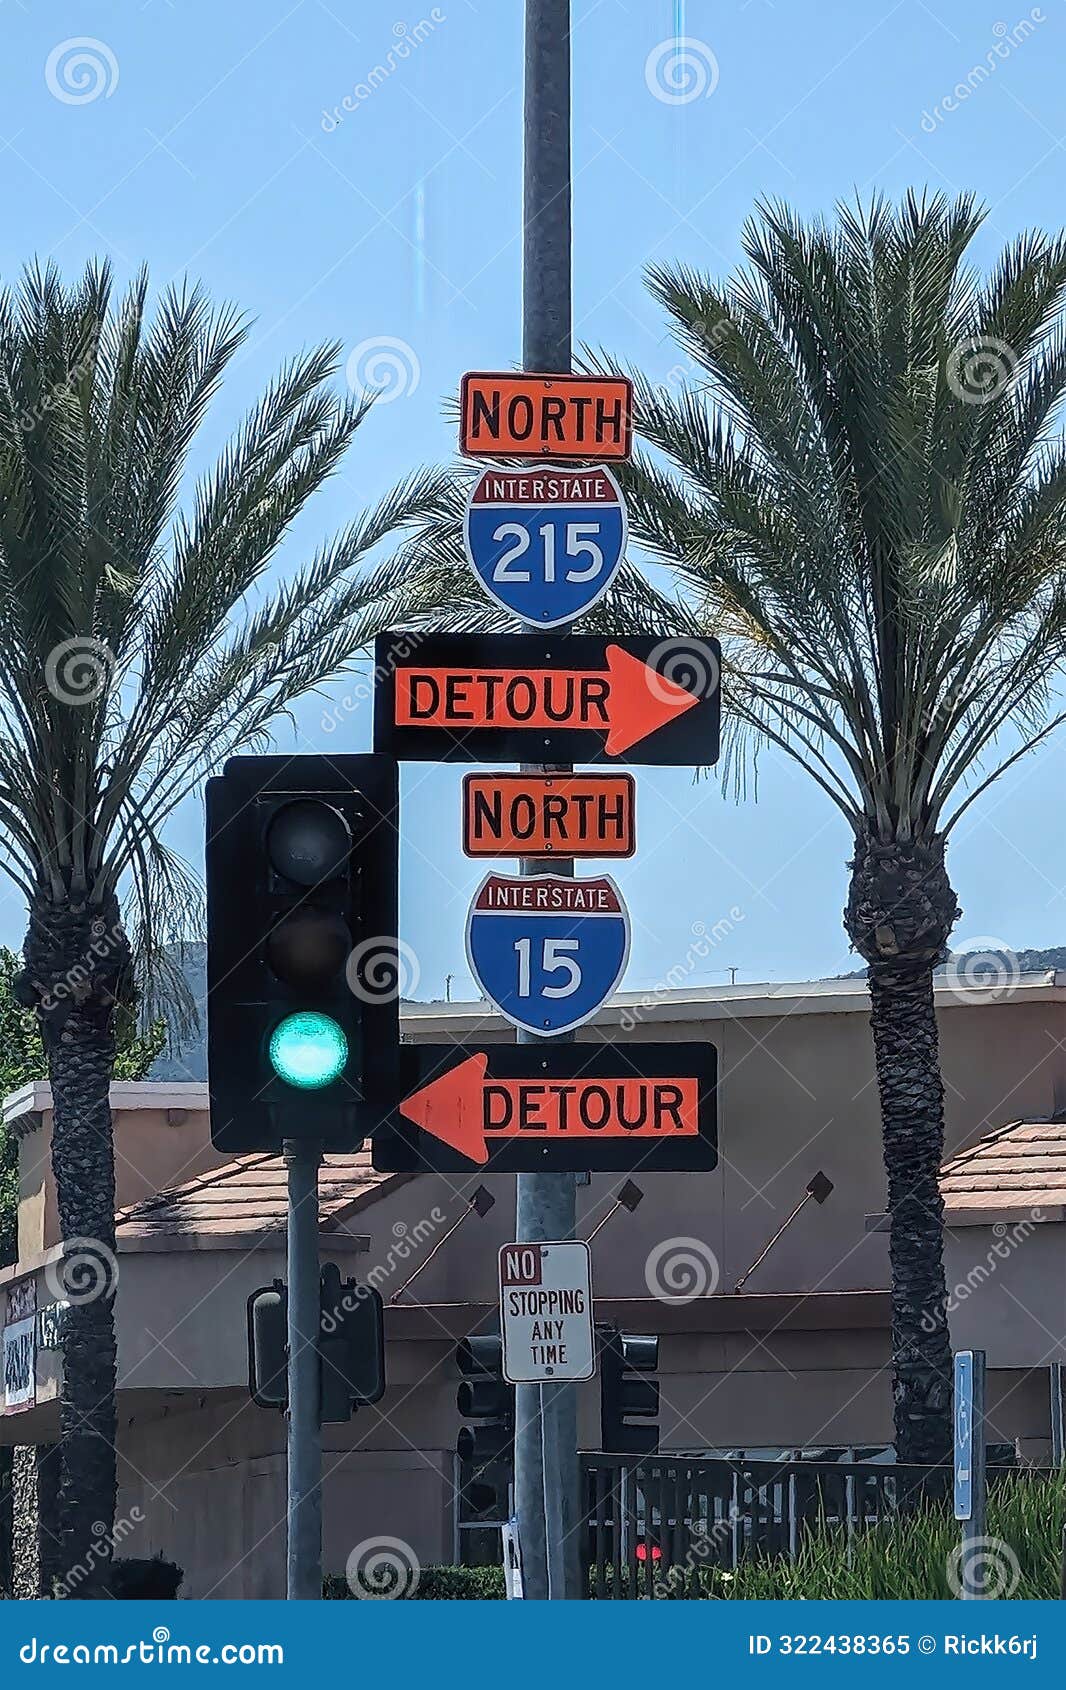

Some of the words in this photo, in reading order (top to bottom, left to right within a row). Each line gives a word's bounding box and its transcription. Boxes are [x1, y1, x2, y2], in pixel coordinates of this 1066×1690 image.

[471, 390, 621, 443] NORTH
[485, 479, 606, 499] INTERSTATE
[492, 523, 604, 583] 215
[409, 674, 611, 722] DETOUR
[474, 791, 624, 839] NORTH
[488, 886, 609, 908] INTERSTATE
[514, 938, 582, 999] 15
[483, 1085, 684, 1130] DETOUR
[506, 1250, 535, 1280] NO
[509, 1289, 585, 1317] STOPPING
[531, 1320, 564, 1341] ANY
[530, 1344, 568, 1365] TIME
